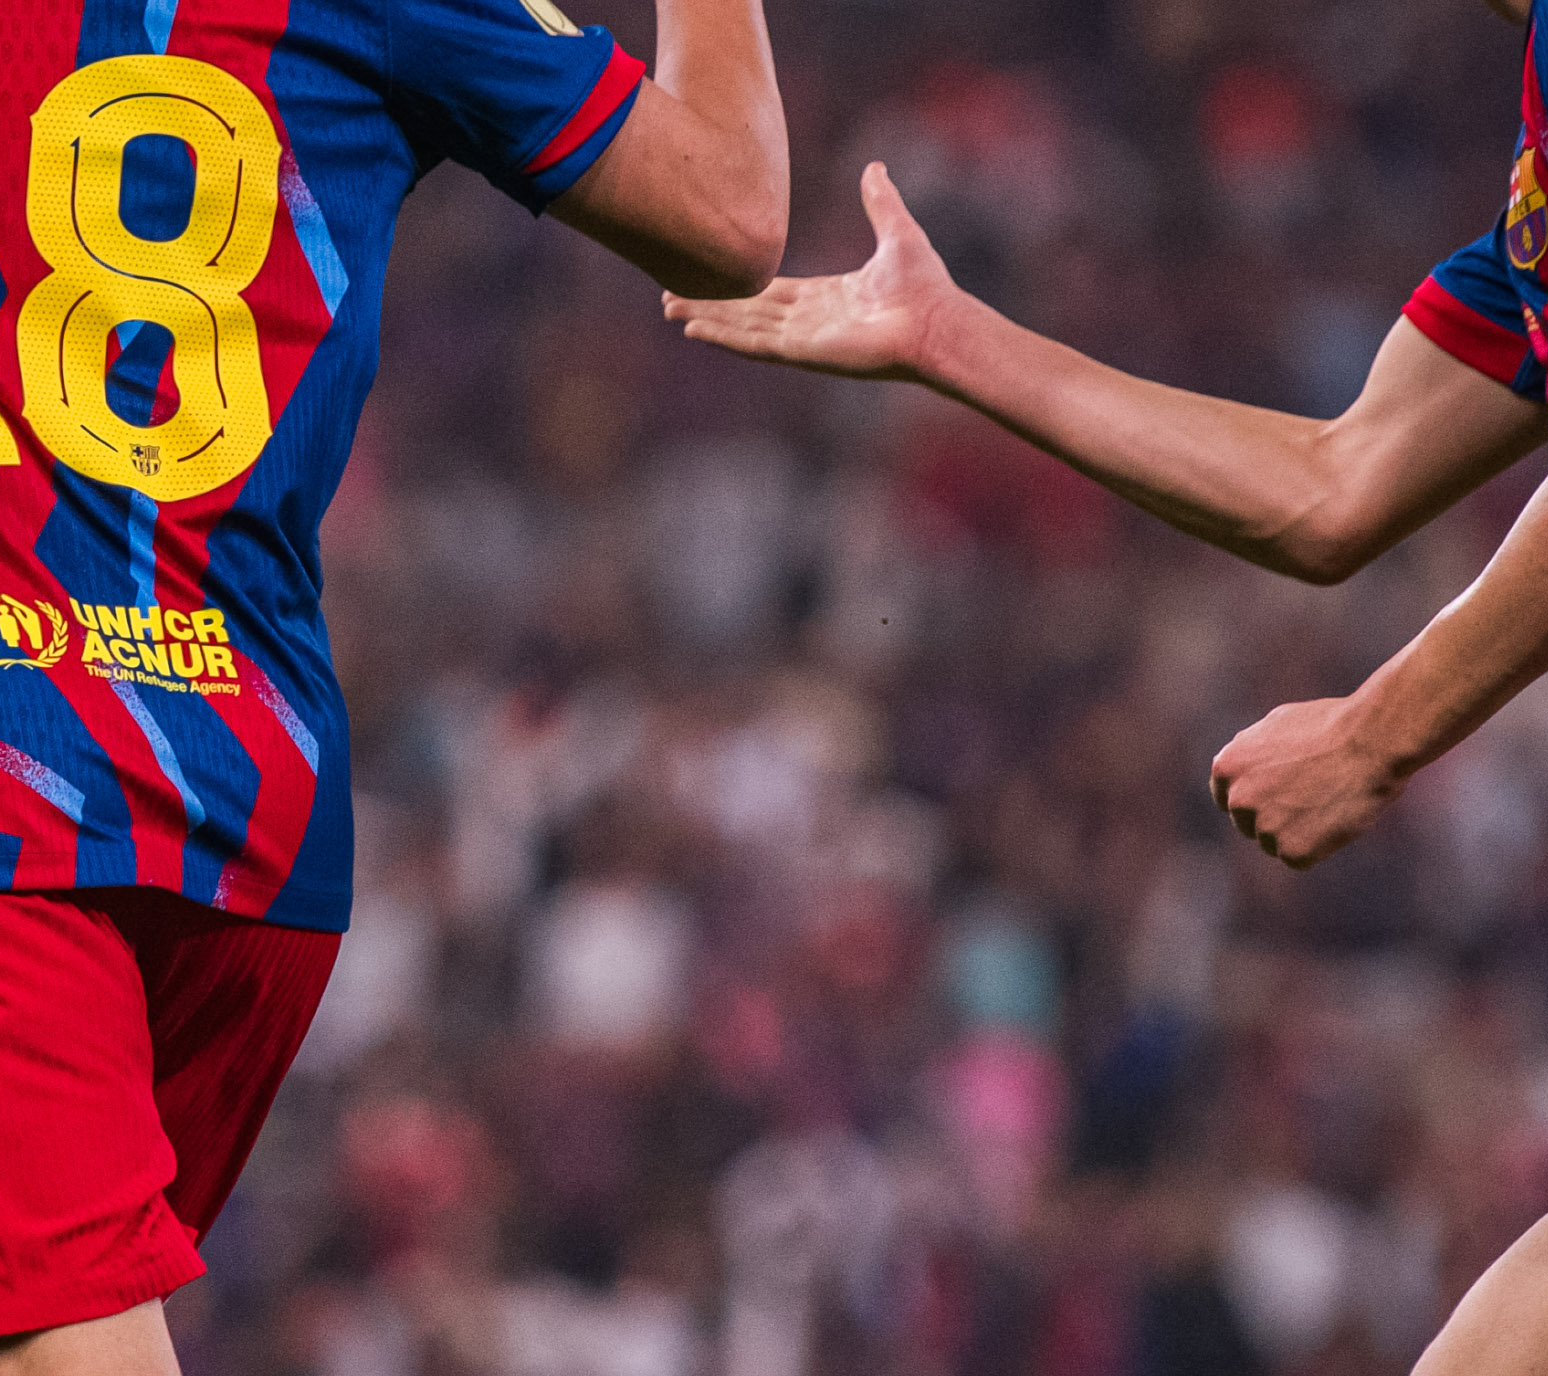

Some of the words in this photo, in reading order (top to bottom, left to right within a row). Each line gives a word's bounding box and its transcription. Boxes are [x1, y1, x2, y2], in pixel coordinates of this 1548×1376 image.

[69, 597, 229, 643] UNHCR
[81, 630, 239, 679] ACNUR
[84, 664, 112, 679] The
[113, 667, 135, 682] UN
[136, 671, 187, 693] Refugee
[190, 680, 241, 697] Agency
